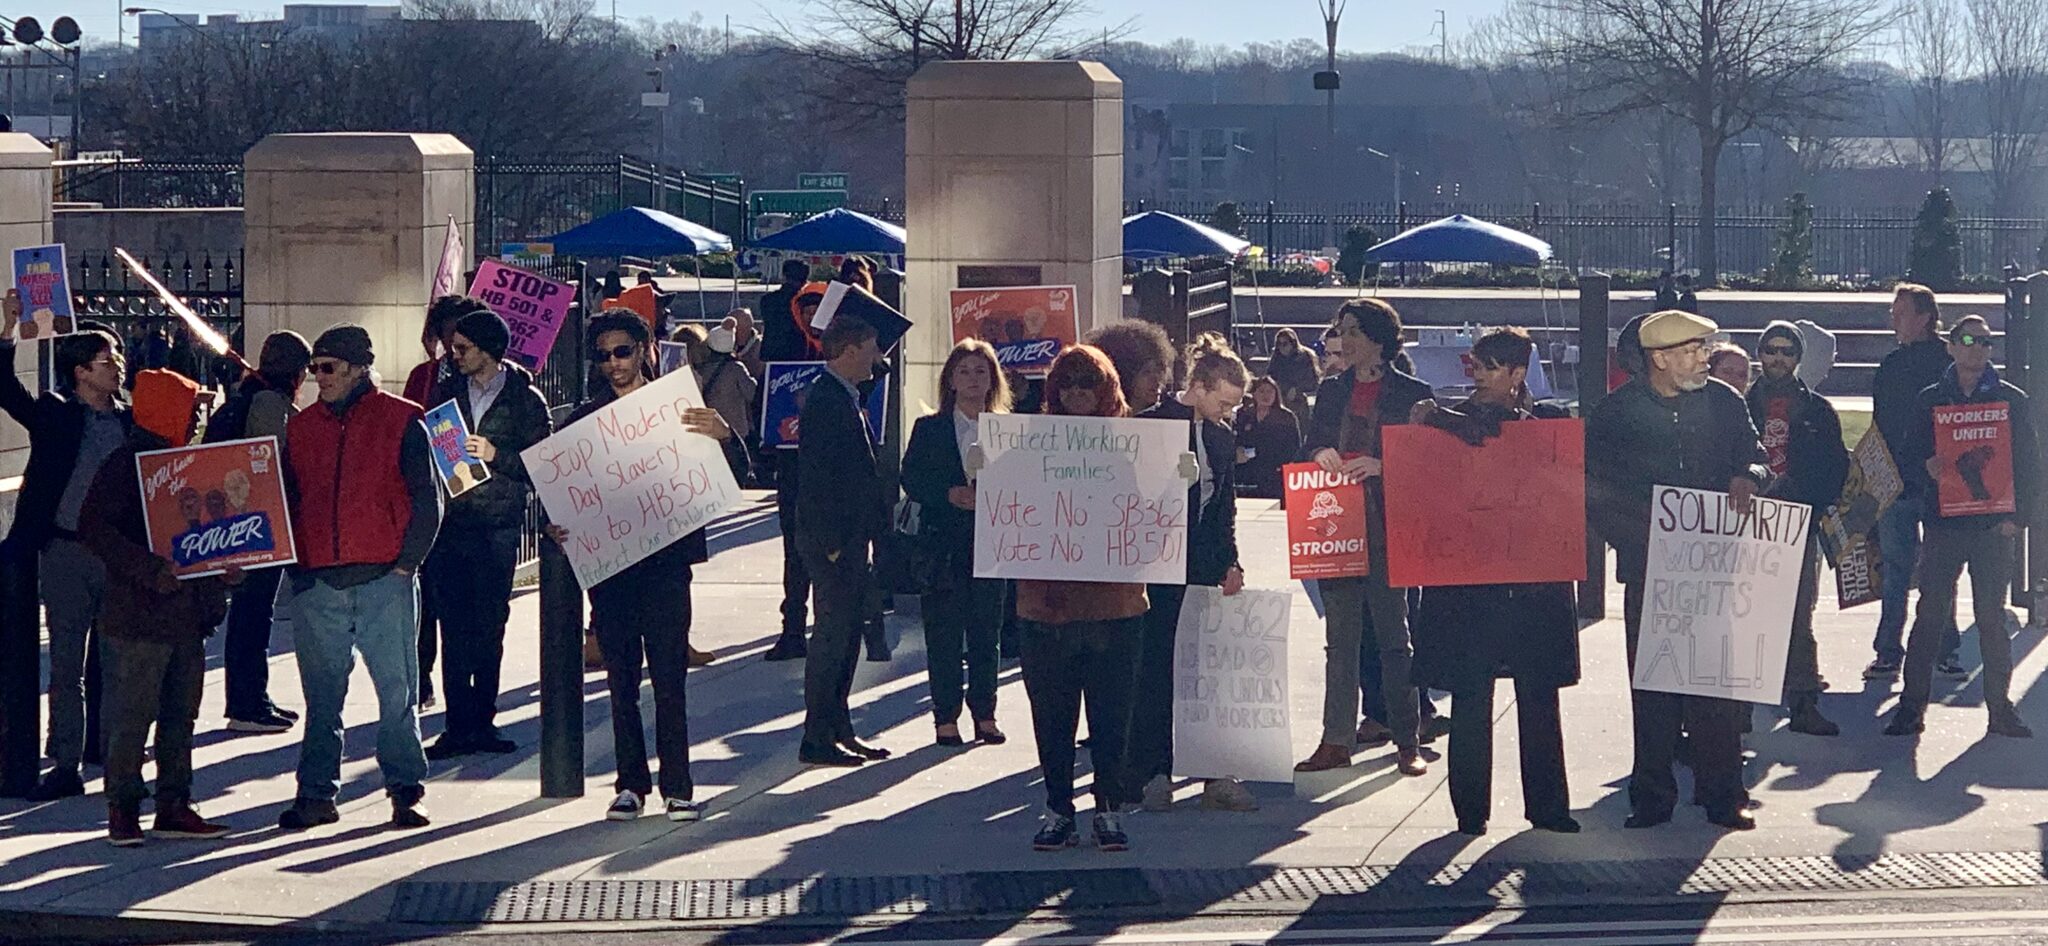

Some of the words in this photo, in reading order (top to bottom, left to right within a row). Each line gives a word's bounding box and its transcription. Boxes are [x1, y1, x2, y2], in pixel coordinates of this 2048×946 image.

[493, 268, 559, 301] STOP
[480, 288, 506, 306] HB
[508, 297, 538, 317] 501
[541, 308, 554, 324] &
[997, 340, 1055, 363] OWER
[1936, 409, 2009, 425] WORKERS
[1952, 427, 1998, 441] UNITE!
[539, 438, 593, 484] Stop
[597, 397, 693, 454] Modern
[988, 419, 1057, 450] Protect
[1066, 423, 1140, 464] Working
[568, 483, 603, 517] Day
[606, 439, 681, 491] Slavery
[1042, 455, 1116, 482] Families
[575, 530, 600, 560] No
[608, 515, 632, 541] to
[637, 463, 712, 528] HB501
[985, 489, 1042, 528] Vote
[1105, 493, 1186, 529] SB362
[1659, 488, 1811, 546] SOLIDARITY
[181, 515, 263, 559] POWER
[992, 532, 1042, 563] Vote
[1107, 528, 1183, 567] HB501
[1292, 538, 1364, 557] STRONG!
[1659, 538, 1782, 577] WORKING
[1840, 555, 1856, 601] STRO
[1652, 578, 1753, 618] RIGHTS
[1230, 593, 1287, 643] 362
[1652, 613, 1694, 636] FOR
[1206, 643, 1246, 671] BAD
[1642, 633, 1766, 690] ALL!
[1215, 707, 1287, 729] WORKERS
